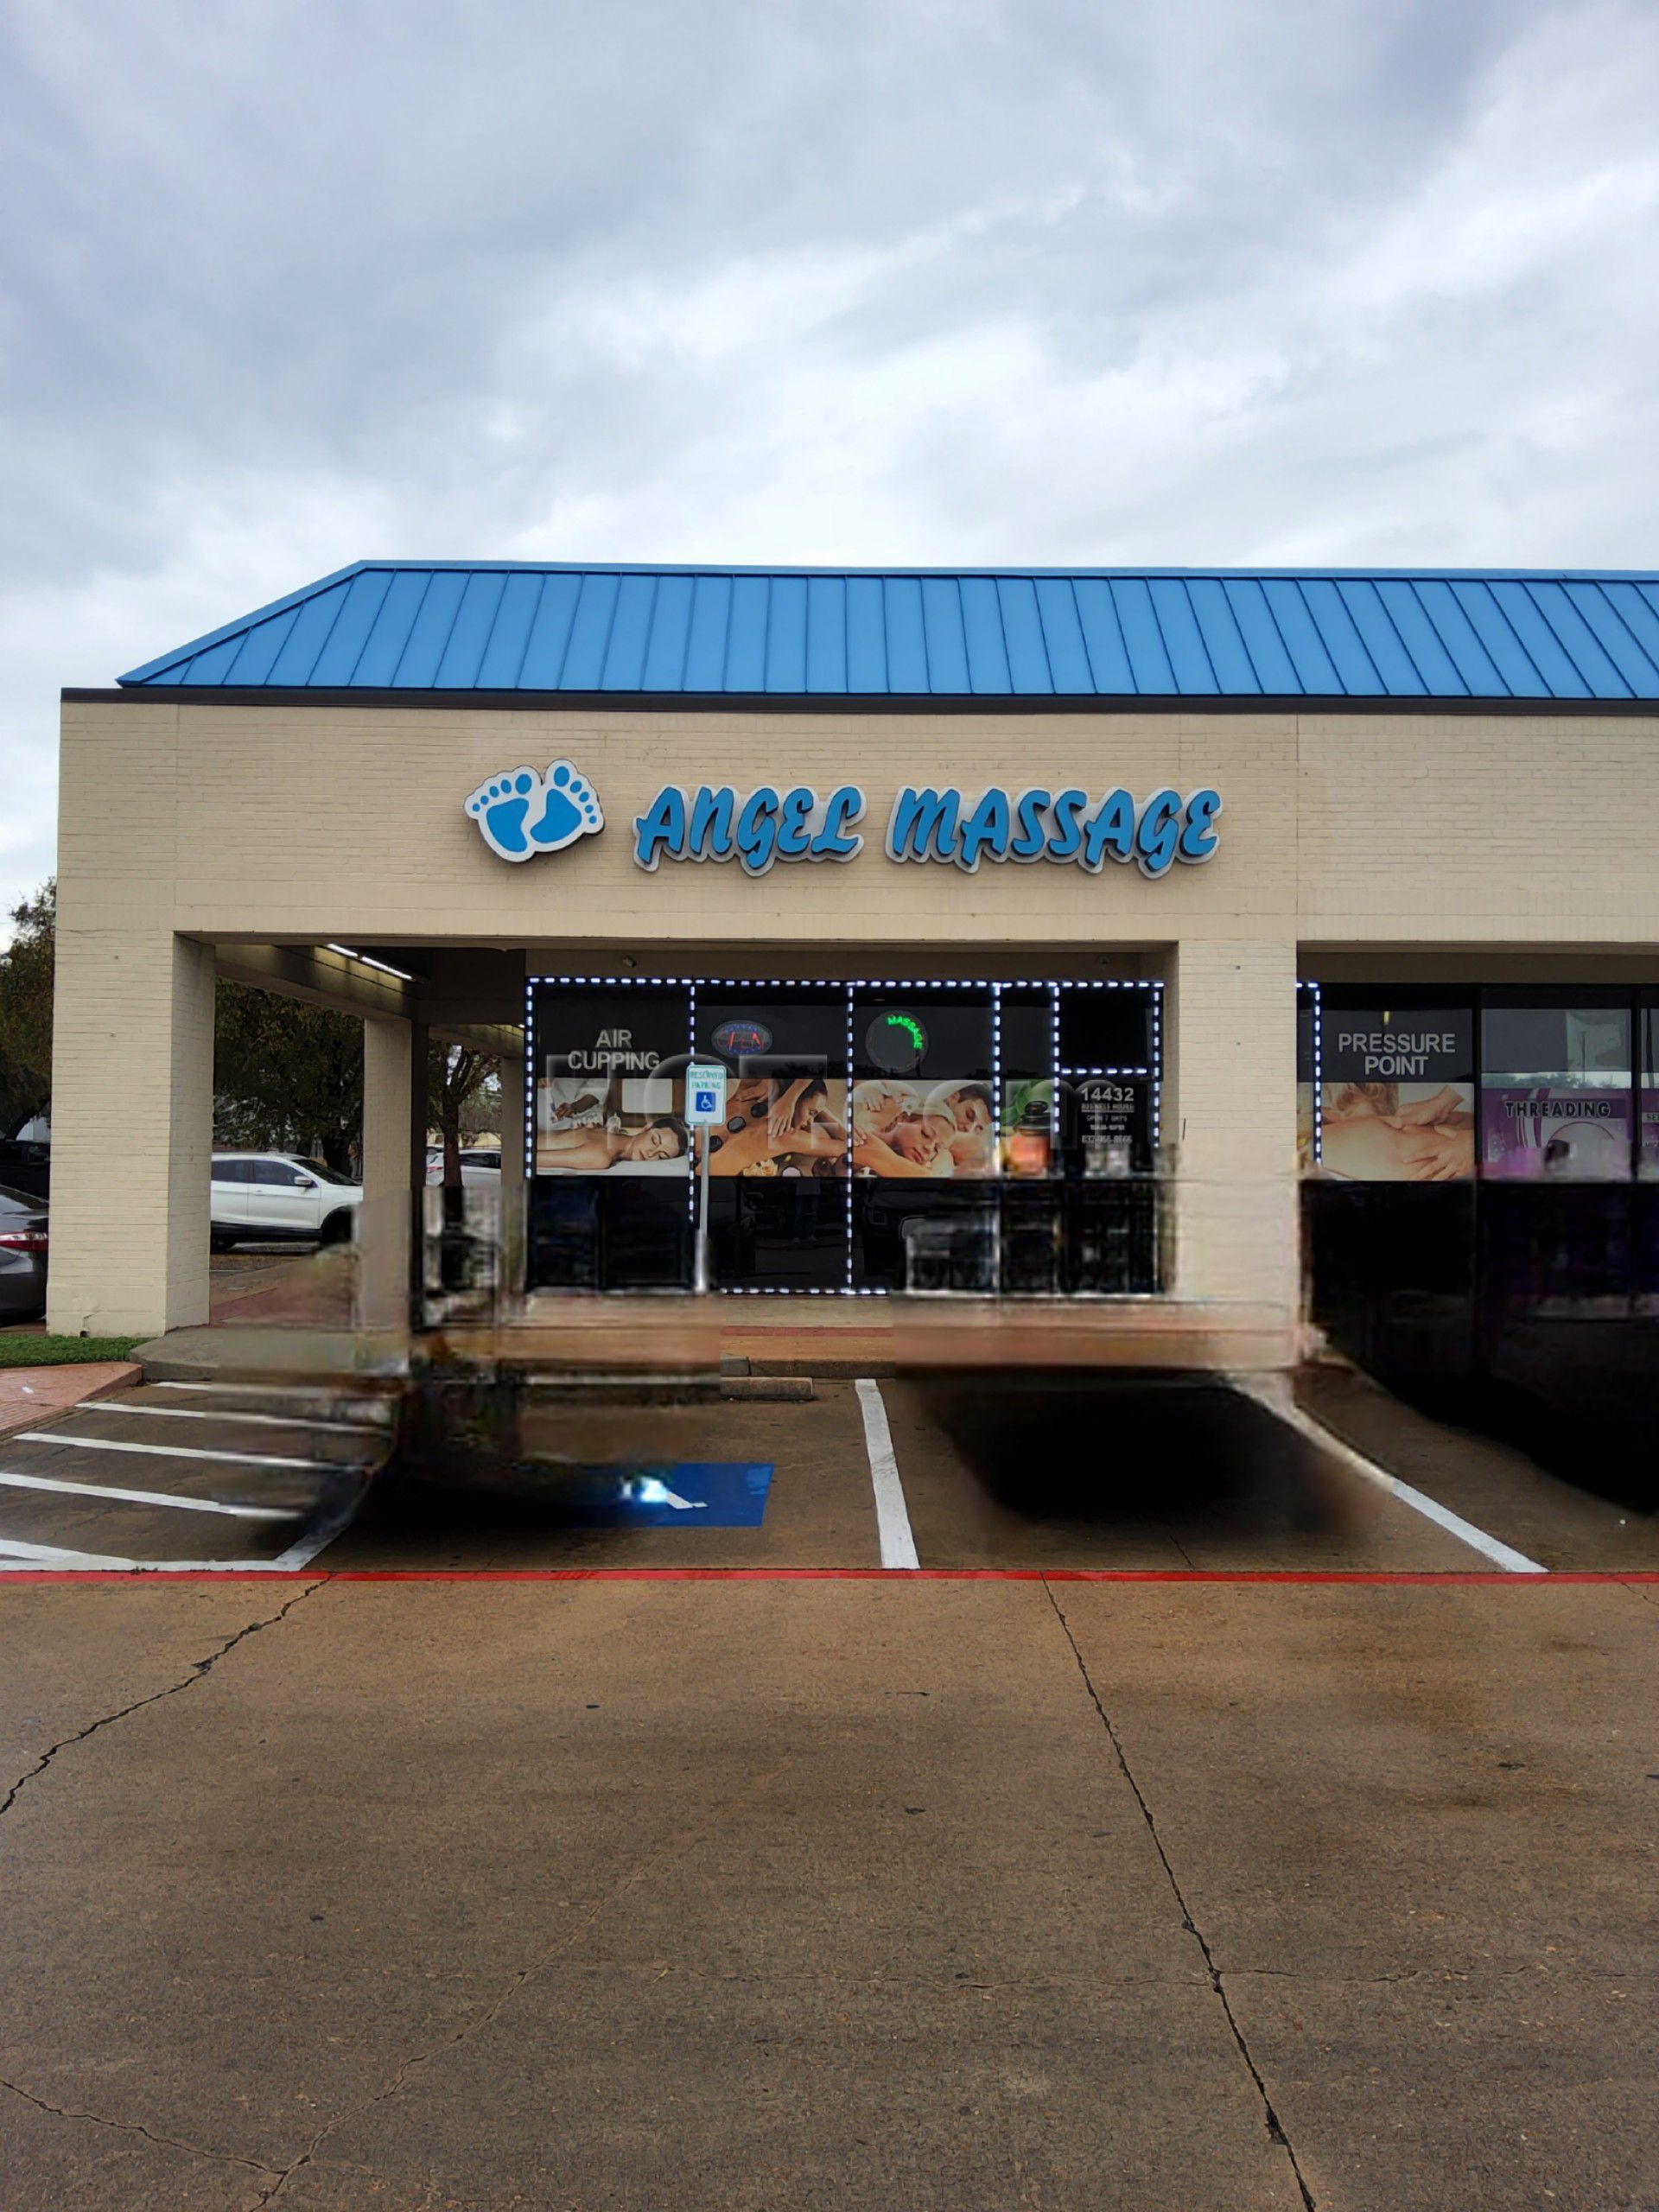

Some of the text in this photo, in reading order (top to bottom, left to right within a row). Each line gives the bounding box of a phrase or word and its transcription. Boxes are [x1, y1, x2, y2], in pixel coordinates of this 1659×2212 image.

[636, 785, 1222, 873] ANGEL MASSAGE
[595, 1029, 632, 1048] AIR
[887, 1015, 924, 1051] MASSAGE
[1338, 1033, 1456, 1054] PRESSURE
[568, 1051, 660, 1071] CUPPING
[1364, 1056, 1428, 1077] POINT
[1081, 1087, 1135, 1102] 14432
[1505, 1100, 1611, 1119] THREADING
